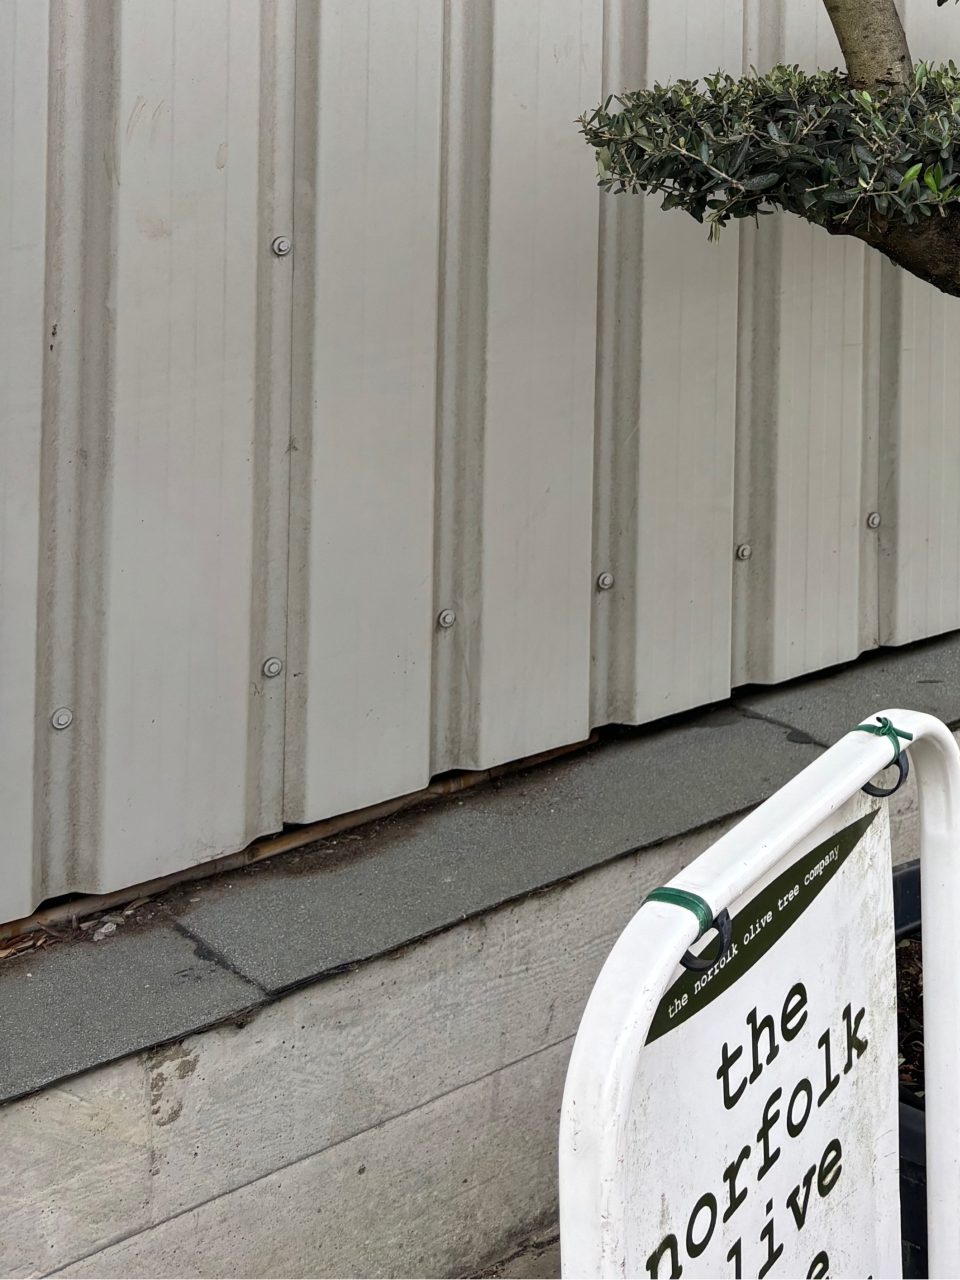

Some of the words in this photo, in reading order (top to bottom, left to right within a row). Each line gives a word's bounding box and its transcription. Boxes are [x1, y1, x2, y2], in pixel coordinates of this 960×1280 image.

[668, 993, 689, 1019] the
[743, 910, 773, 946] olive
[777, 883, 800, 911] tree
[803, 844, 840, 886] company
[716, 981, 809, 1110] the
[645, 1002, 869, 1280] norfolk
